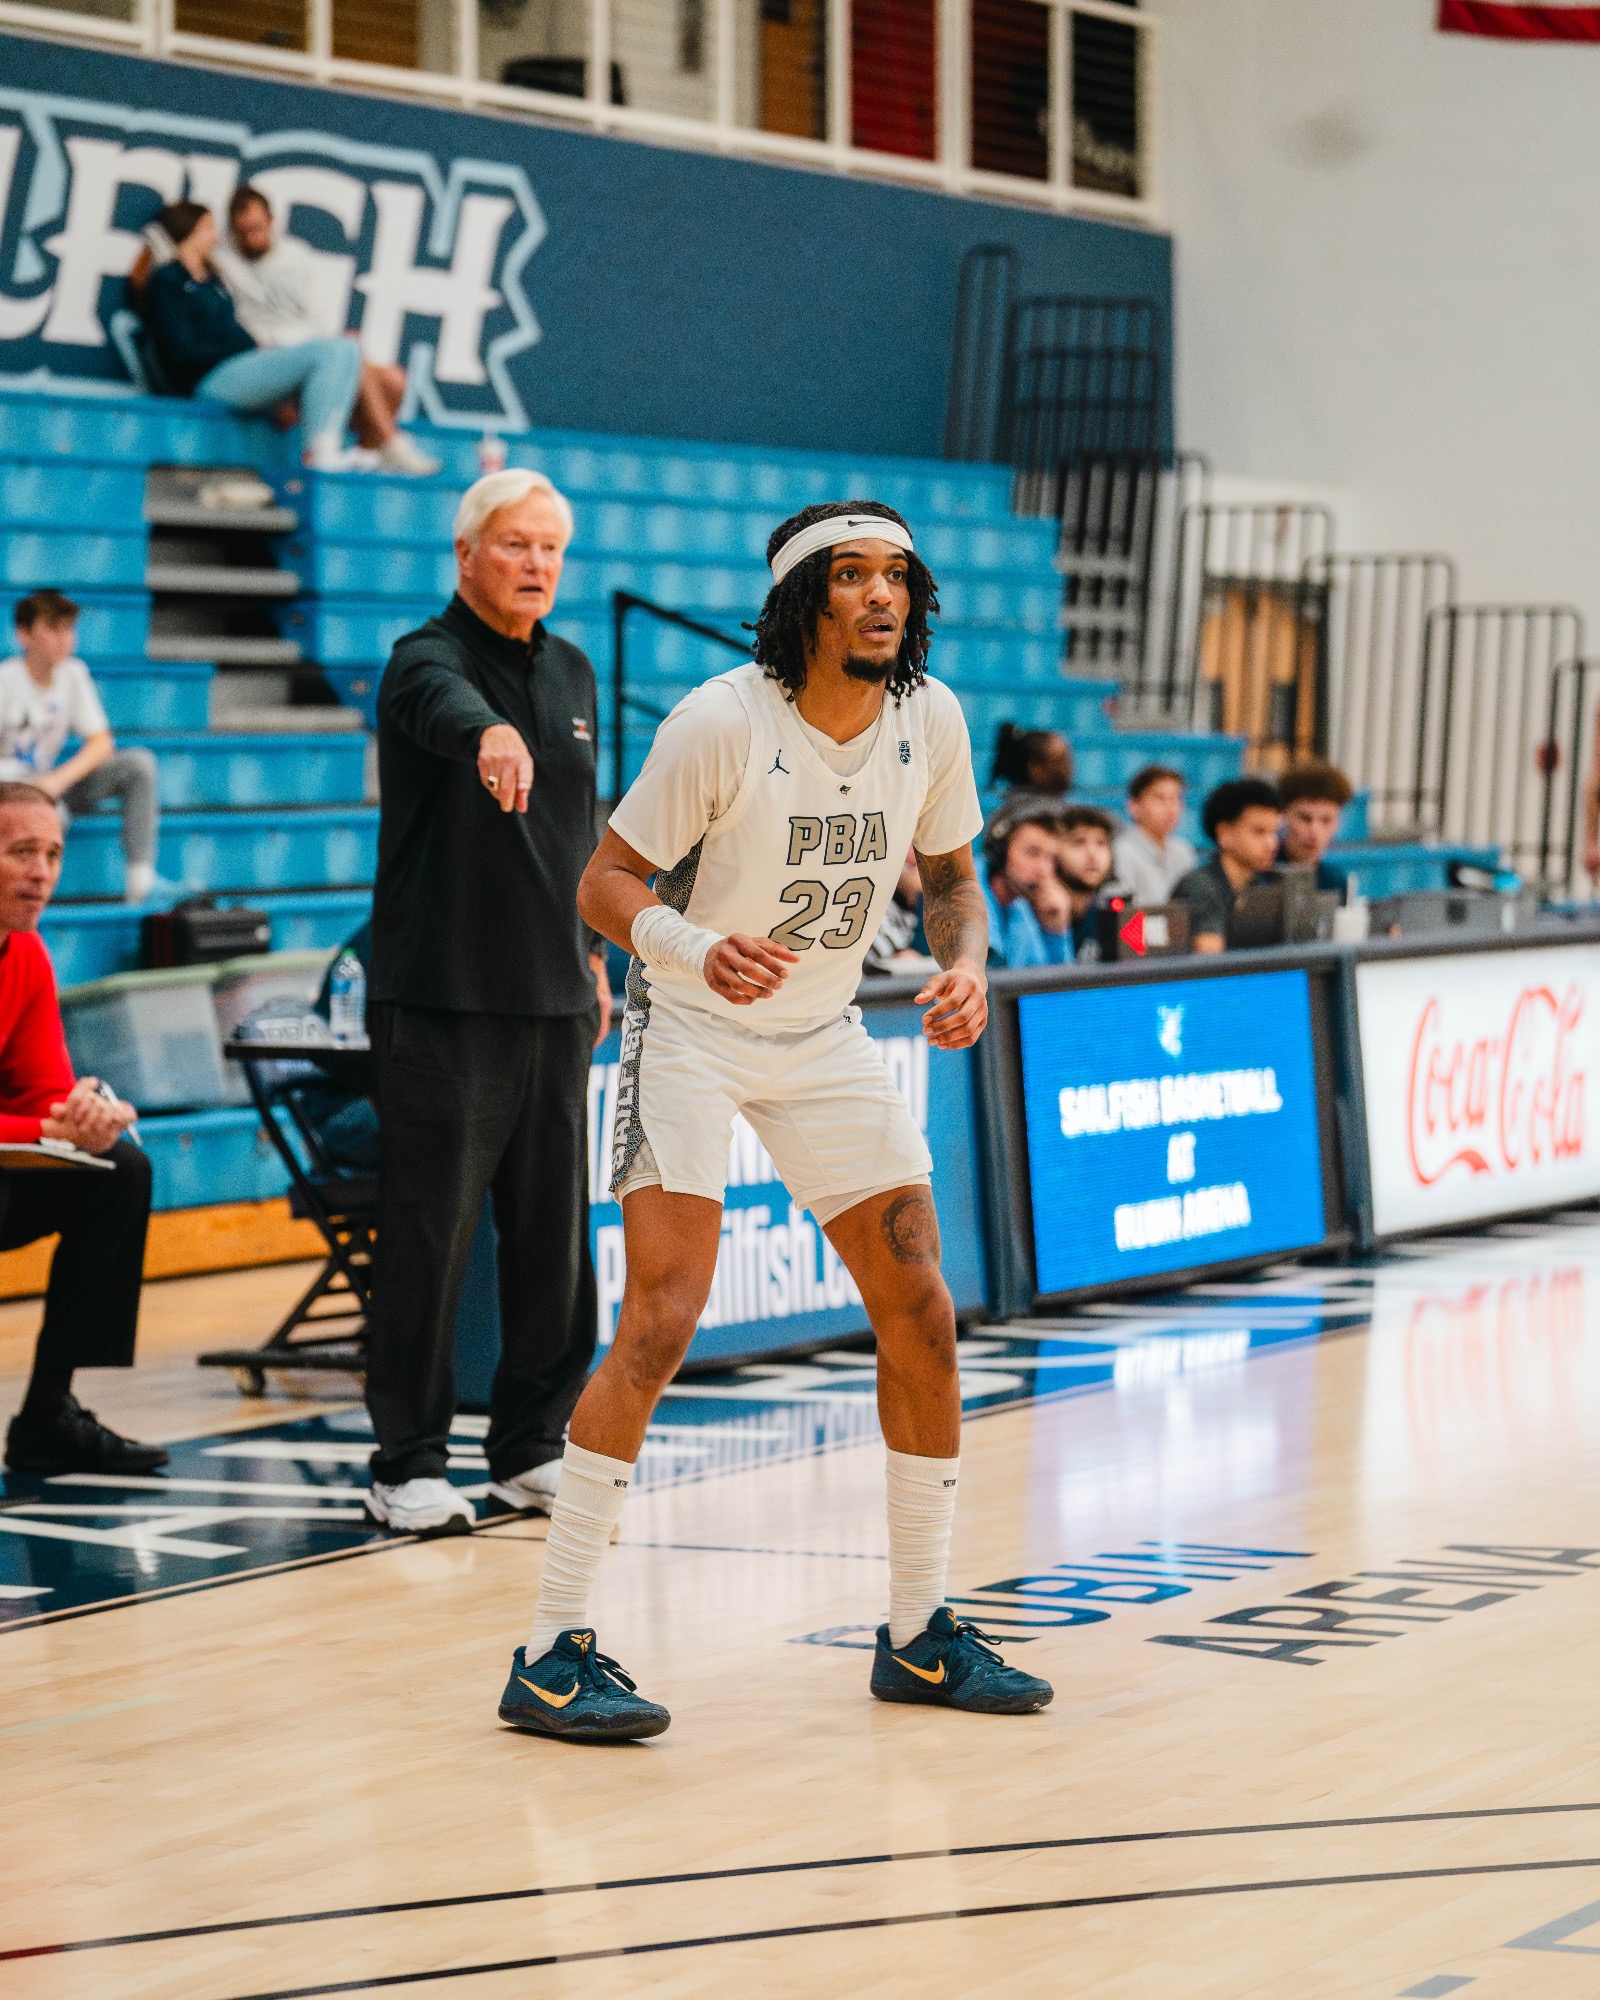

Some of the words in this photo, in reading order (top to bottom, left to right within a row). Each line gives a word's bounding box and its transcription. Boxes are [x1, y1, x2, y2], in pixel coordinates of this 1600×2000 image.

[786, 811, 888, 866] PBA
[768, 876, 876, 952] 23
[1406, 983, 1587, 1187] Coca-Cola
[1144, 1543, 1600, 1666] ARENA
